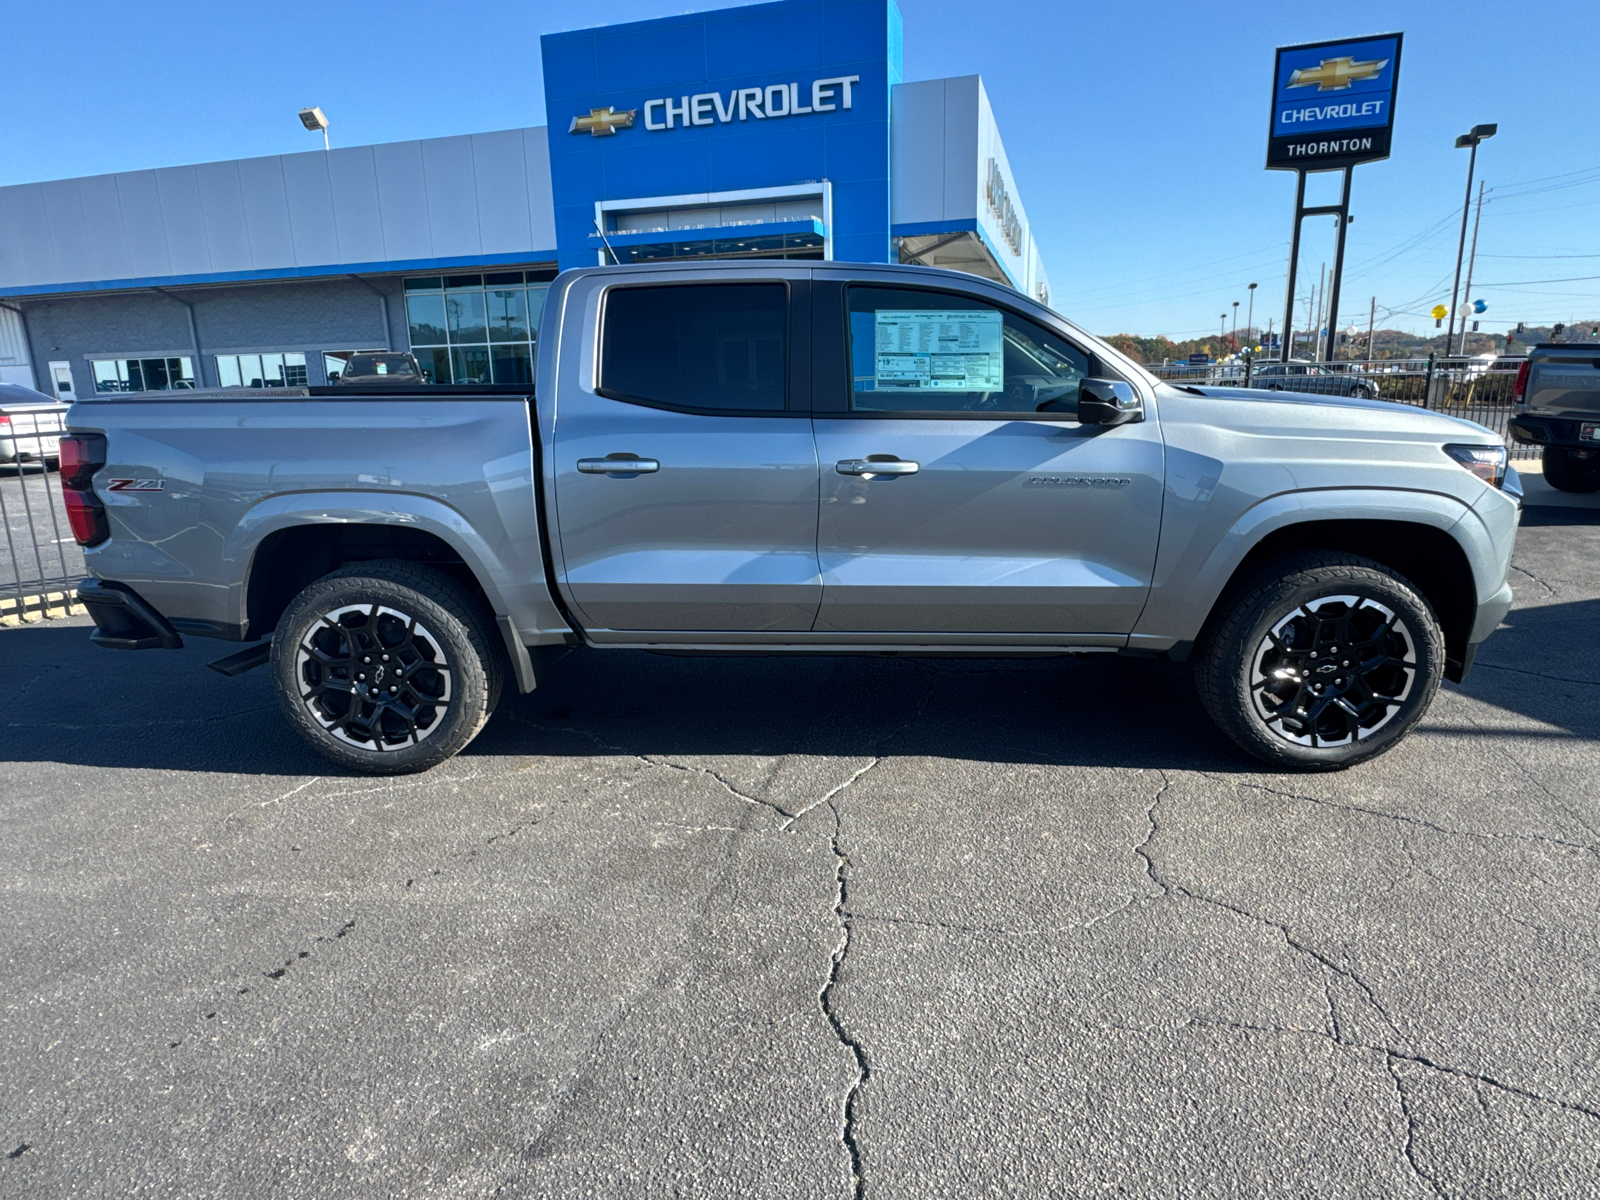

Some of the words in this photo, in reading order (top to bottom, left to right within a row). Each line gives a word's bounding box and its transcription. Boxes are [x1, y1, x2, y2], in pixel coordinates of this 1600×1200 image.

[644, 75, 859, 131] CHEVROLET
[1281, 100, 1384, 124] CHEVROLET
[1287, 137, 1372, 156] THORNTON
[1539, 376, 1600, 386] CHEV
[105, 478, 167, 493] Z71
